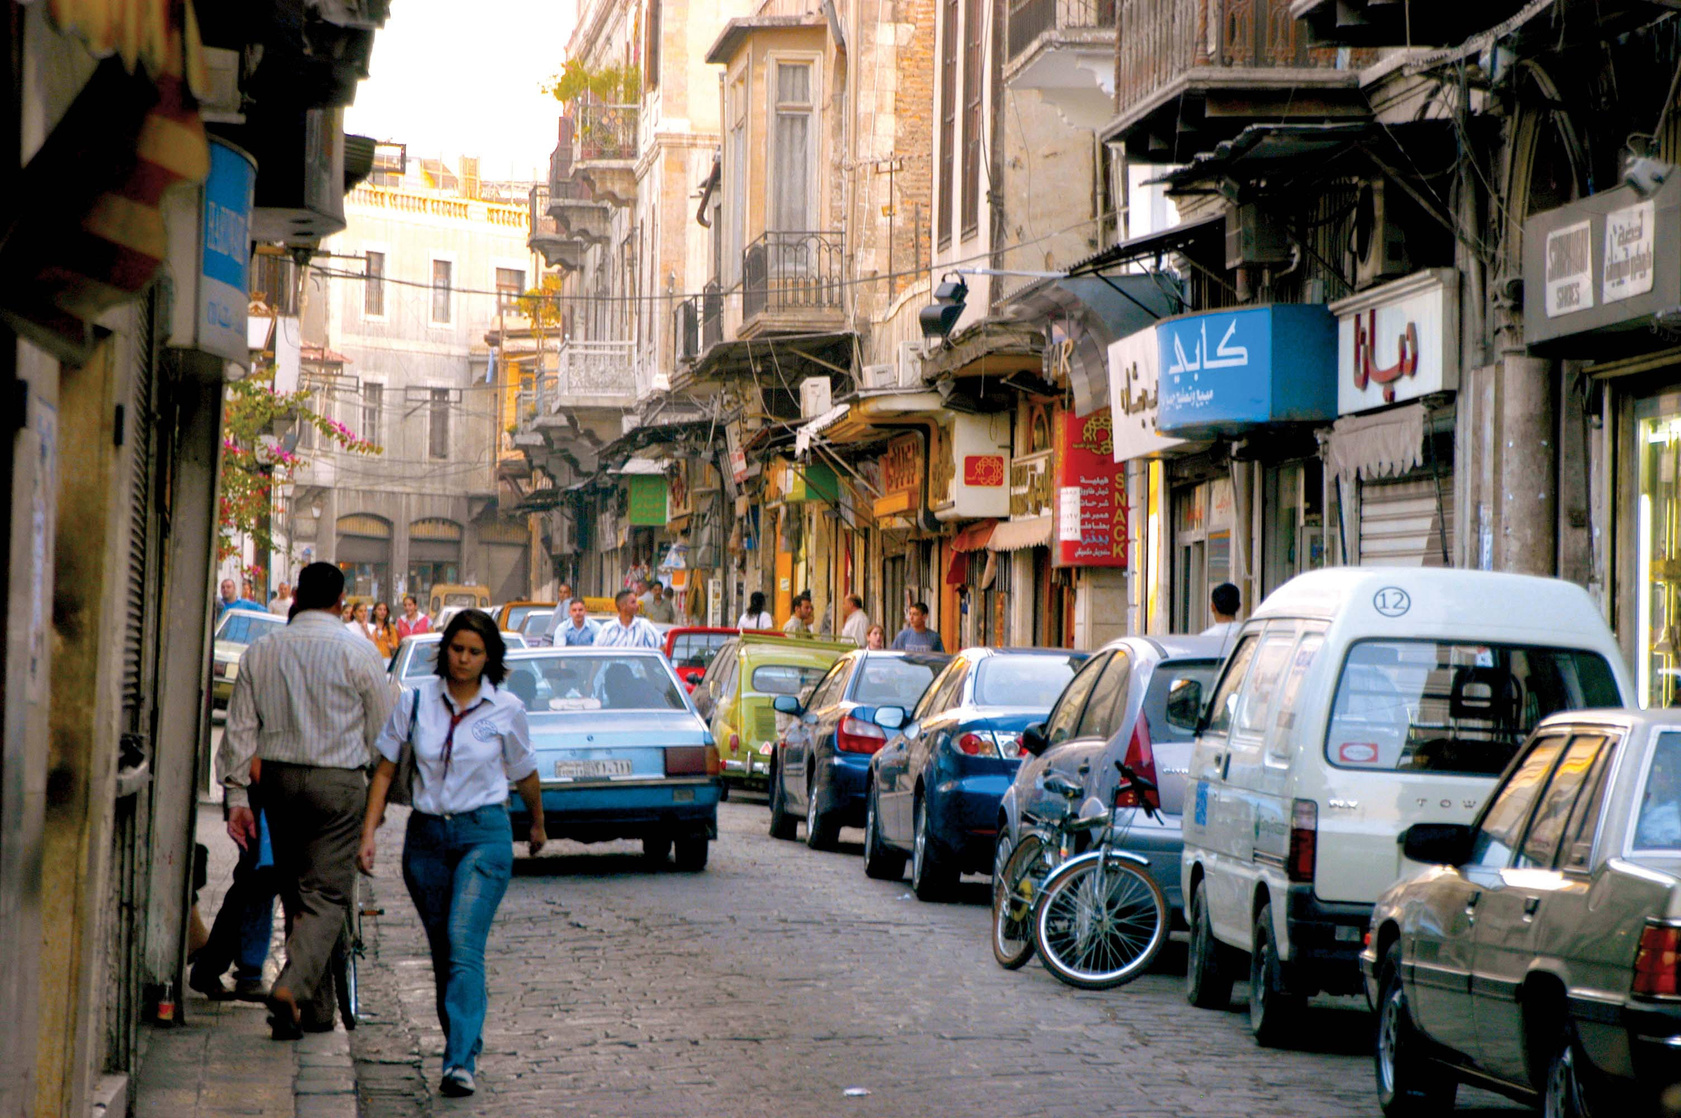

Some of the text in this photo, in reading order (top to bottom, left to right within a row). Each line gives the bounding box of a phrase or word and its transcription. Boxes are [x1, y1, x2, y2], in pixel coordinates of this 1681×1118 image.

[1169, 318, 1248, 384] كابي
[1112, 473, 1127, 559] SNACK
[1379, 592, 1405, 610] 12
